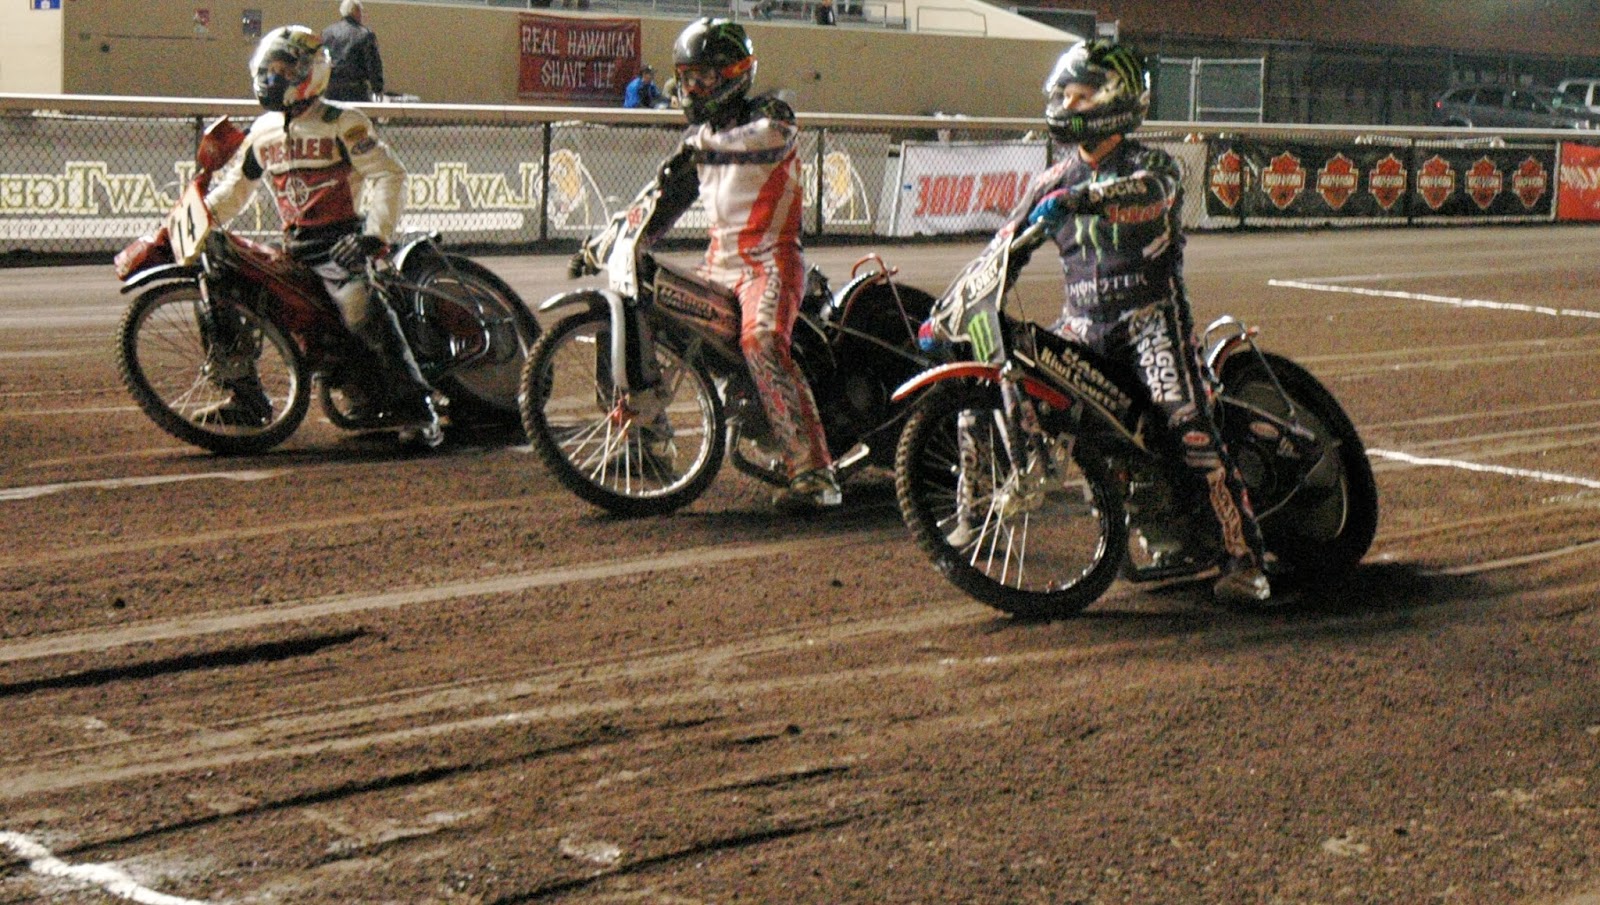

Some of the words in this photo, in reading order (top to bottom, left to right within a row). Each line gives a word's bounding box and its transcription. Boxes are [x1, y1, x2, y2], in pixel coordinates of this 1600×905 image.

[522, 25, 559, 55] REAL
[567, 29, 636, 58] HAWAIIAN
[541, 60, 587, 88] SHAVE
[593, 61, 615, 89] ICE
